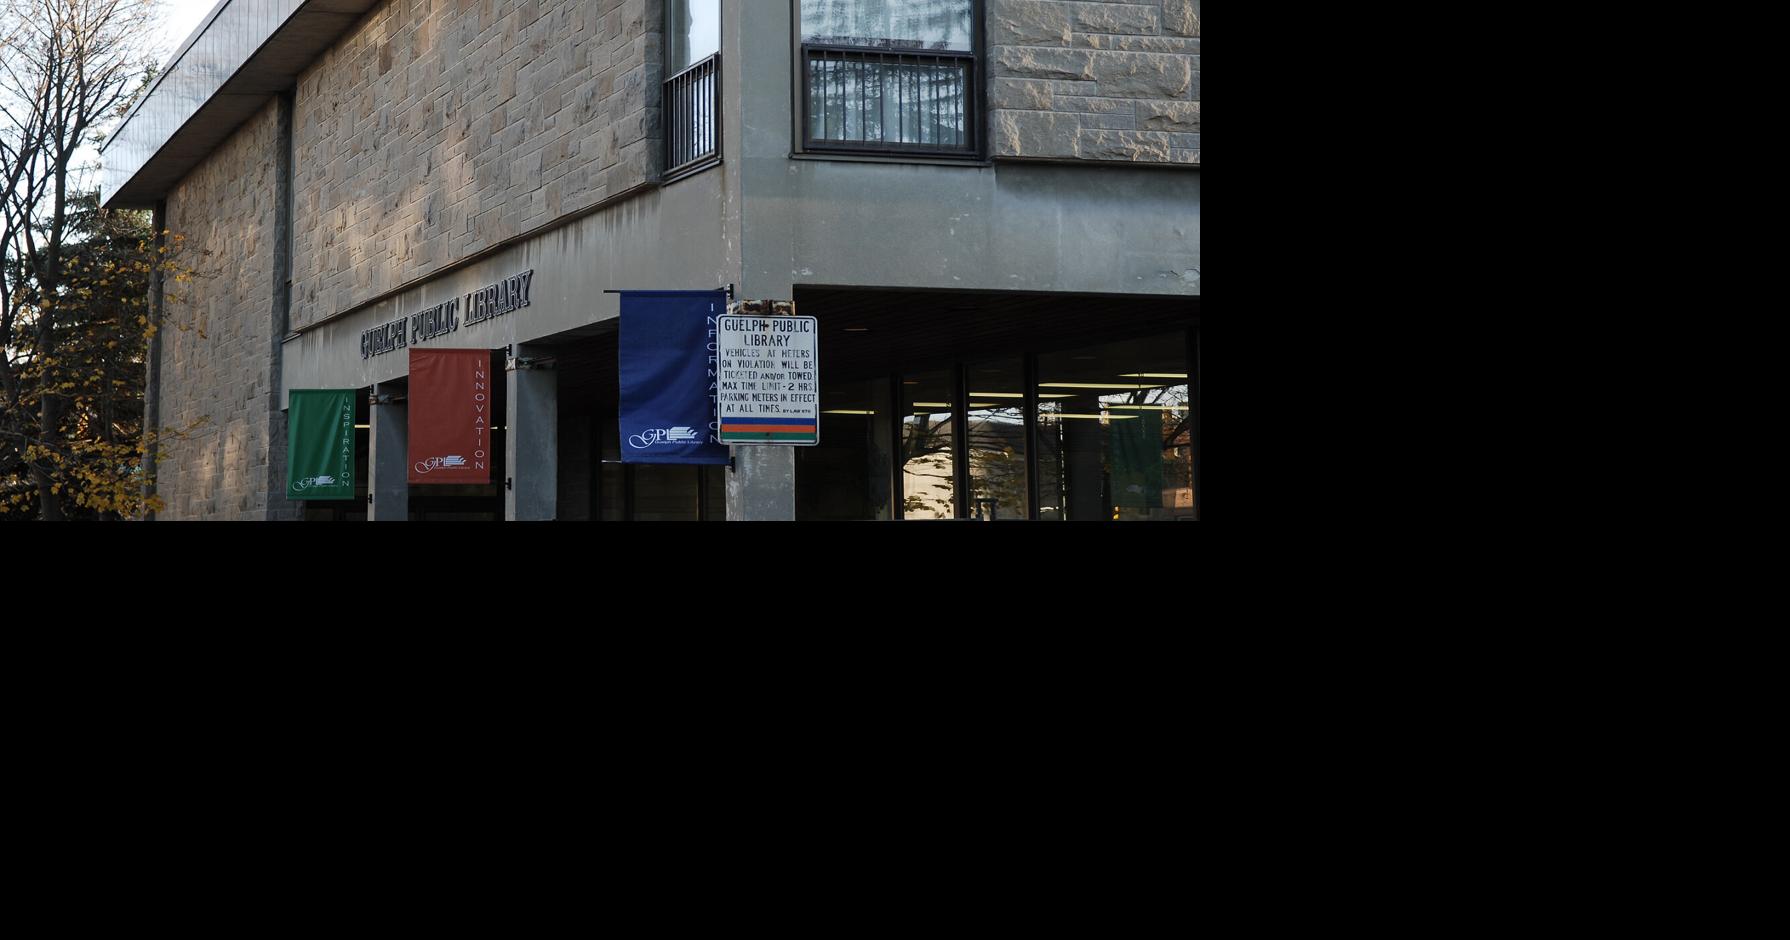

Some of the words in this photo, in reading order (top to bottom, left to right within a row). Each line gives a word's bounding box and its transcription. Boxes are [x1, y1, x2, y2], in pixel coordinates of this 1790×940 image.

[360, 316, 407, 359] GUELPH
[410, 297, 460, 345] PUBLIC
[463, 269, 533, 327] LIBRARY
[724, 319, 766, 331] GUELPH
[773, 320, 810, 333] PUBLIC
[744, 334, 791, 347] LIBRARY
[725, 348, 760, 358] VEHICLES
[767, 349, 776, 358] AT
[782, 349, 810, 358] METERS
[722, 360, 732, 369] ON
[738, 360, 775, 369] VIOLATION
[781, 361, 799, 370] WILL
[804, 361, 813, 370] BE
[788, 372, 812, 381] TOWED
[722, 382, 738, 391] MAX
[741, 382, 757, 391] TIME
[762, 382, 781, 391] LIMIT
[788, 383, 795, 391] 2
[720, 393, 749, 402] PARKING
[752, 393, 778, 402] METERS
[781, 394, 787, 402] IN
[791, 394, 816, 403] EFFECT
[726, 404, 734, 412] AT
[740, 404, 753, 413] ALL
[475, 359, 485, 470] INNOVATION
[341, 397, 350, 487] INSPIRATION
